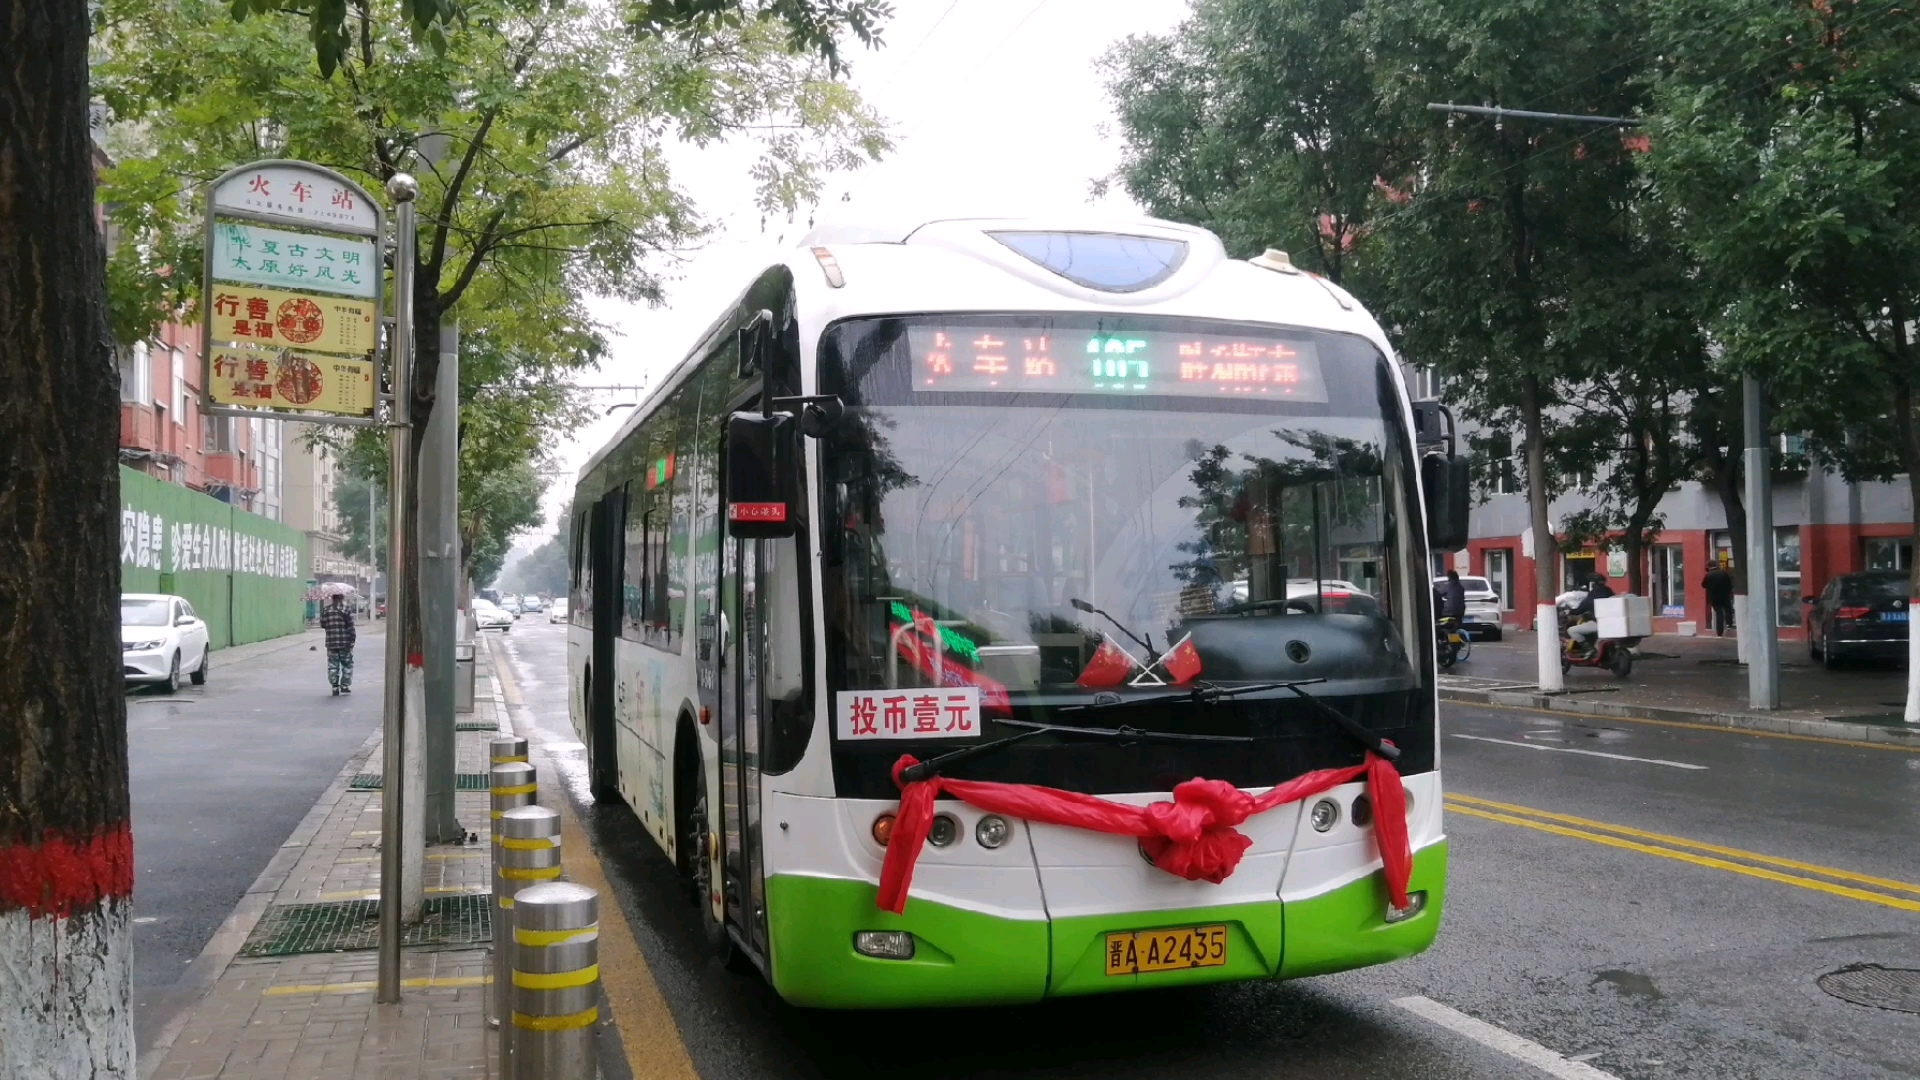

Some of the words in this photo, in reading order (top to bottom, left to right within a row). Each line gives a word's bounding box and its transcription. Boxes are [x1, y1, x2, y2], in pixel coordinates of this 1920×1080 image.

[248, 174, 355, 210] 火车站
[231, 235, 361, 266] 华夏古文明
[231, 256, 361, 284] 太原好风光
[214, 292, 269, 320] 行善
[232, 319, 274, 339] 是福
[213, 354, 269, 381] 行善
[231, 383, 273, 400] 是福
[850, 694, 972, 736] 投币壹元
